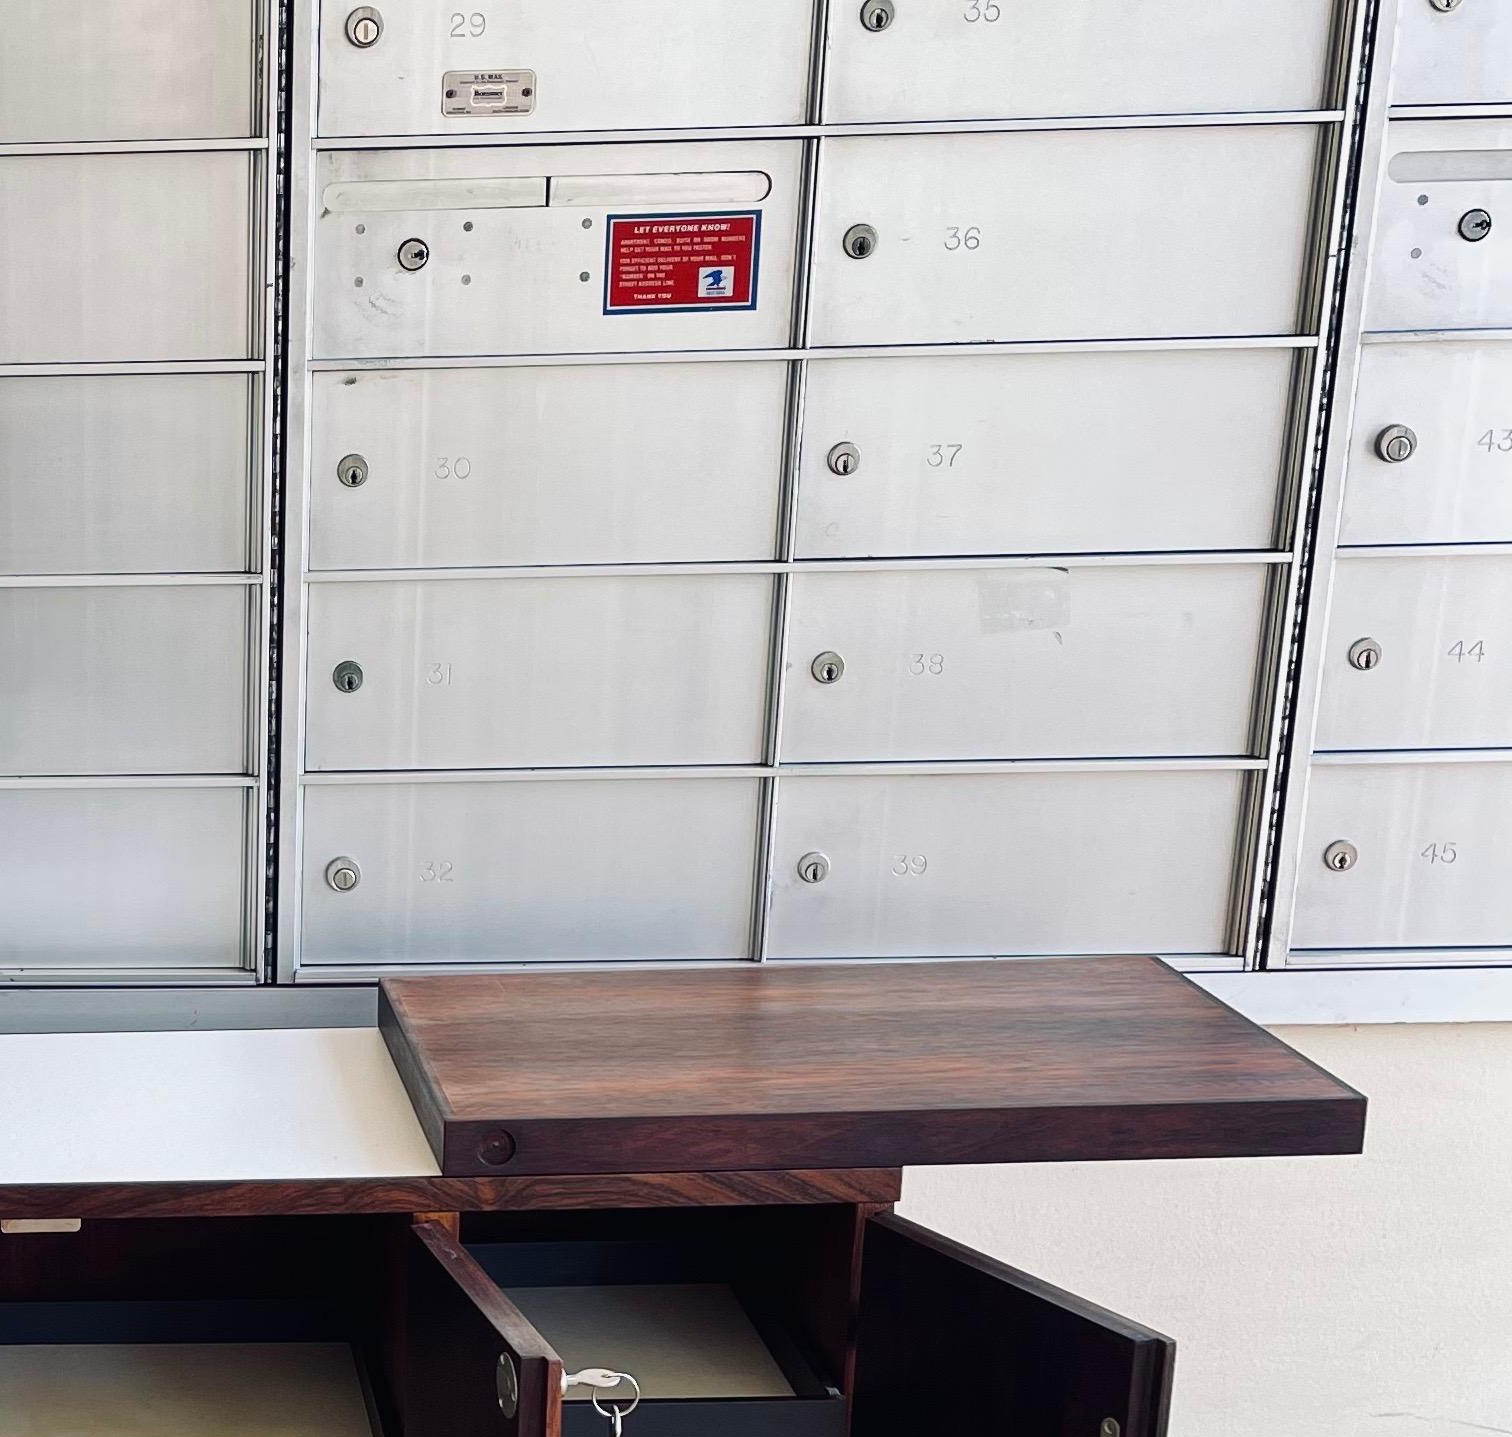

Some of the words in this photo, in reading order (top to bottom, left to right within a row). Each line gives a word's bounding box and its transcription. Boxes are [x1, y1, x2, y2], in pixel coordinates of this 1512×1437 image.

[963, 0, 1000, 22] 35
[449, 12, 486, 39] 29
[653, 225, 698, 233] EVERYONE
[944, 227, 981, 251] 36
[1478, 428, 1512, 453] 43
[927, 443, 963, 468] 37
[434, 456, 472, 480] 30
[1447, 639, 1486, 663] 44
[427, 662, 453, 687] 31
[909, 653, 945, 677] 38
[892, 854, 928, 878] 39
[1421, 843, 1458, 865] 45
[419, 860, 455, 883] 32
